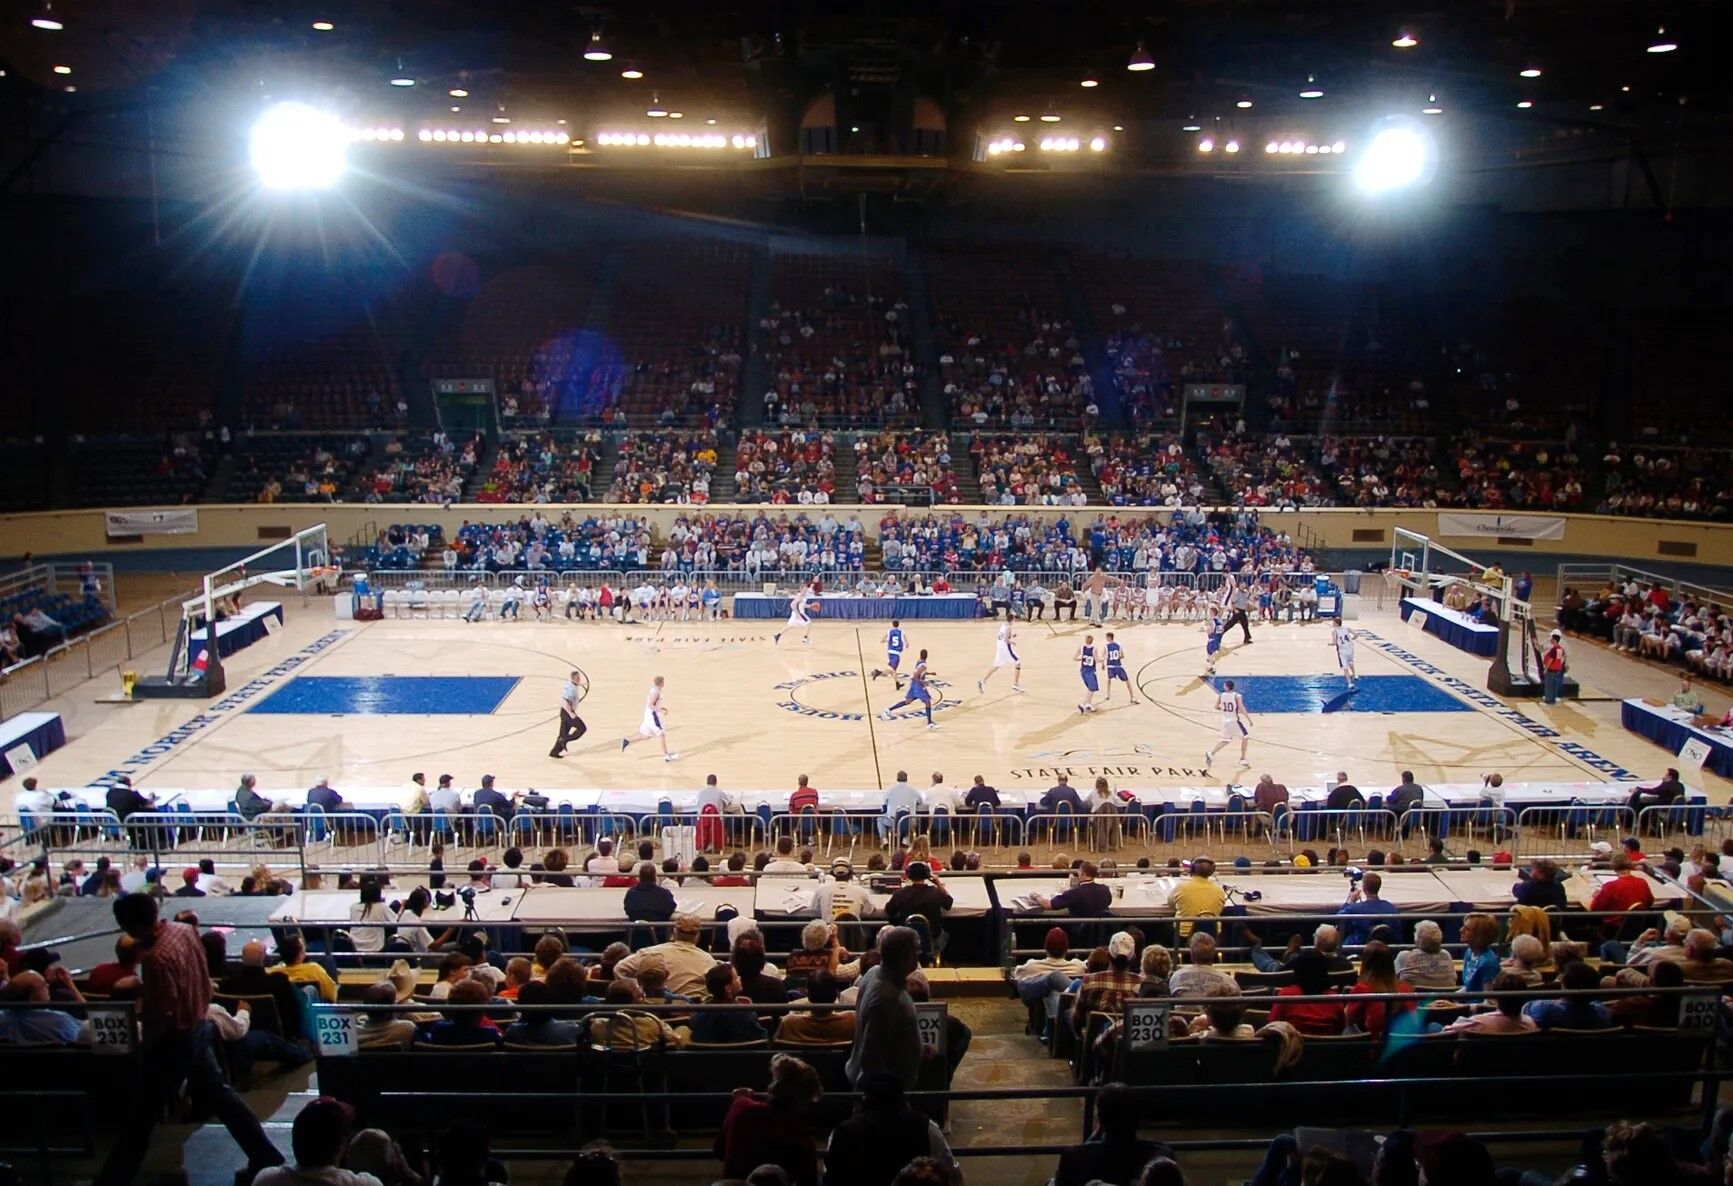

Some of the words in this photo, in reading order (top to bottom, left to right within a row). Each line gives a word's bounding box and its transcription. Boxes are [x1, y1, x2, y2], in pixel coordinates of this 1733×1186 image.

[892, 636, 899, 647] 5
[1109, 650, 1120, 661] 10
[810, 670, 857, 680] BIG
[1373, 643, 1448, 675] NORICK
[1436, 677, 1508, 707] STATE
[1496, 710, 1561, 737] FAIR
[122, 714, 221, 765] NORICK
[208, 679, 274, 711] STATE
[263, 656, 310, 677] FAIR
[299, 629, 354, 654] ARENA
[776, 701, 864, 721] HOUSE
[1223, 701, 1234, 713] 10
[1009, 767, 1079, 779] STATE
[1088, 766, 1142, 777] FAIR
[1150, 767, 1214, 778] PARK
[94, 1018, 127, 1030] BOX
[318, 1018, 351, 1030] BOX
[918, 1018, 940, 1030] OX
[1132, 1014, 1164, 1027] BOX
[97, 1031, 127, 1045] 232
[322, 1031, 349, 1045] 231
[1132, 1028, 1163, 1041] 230
